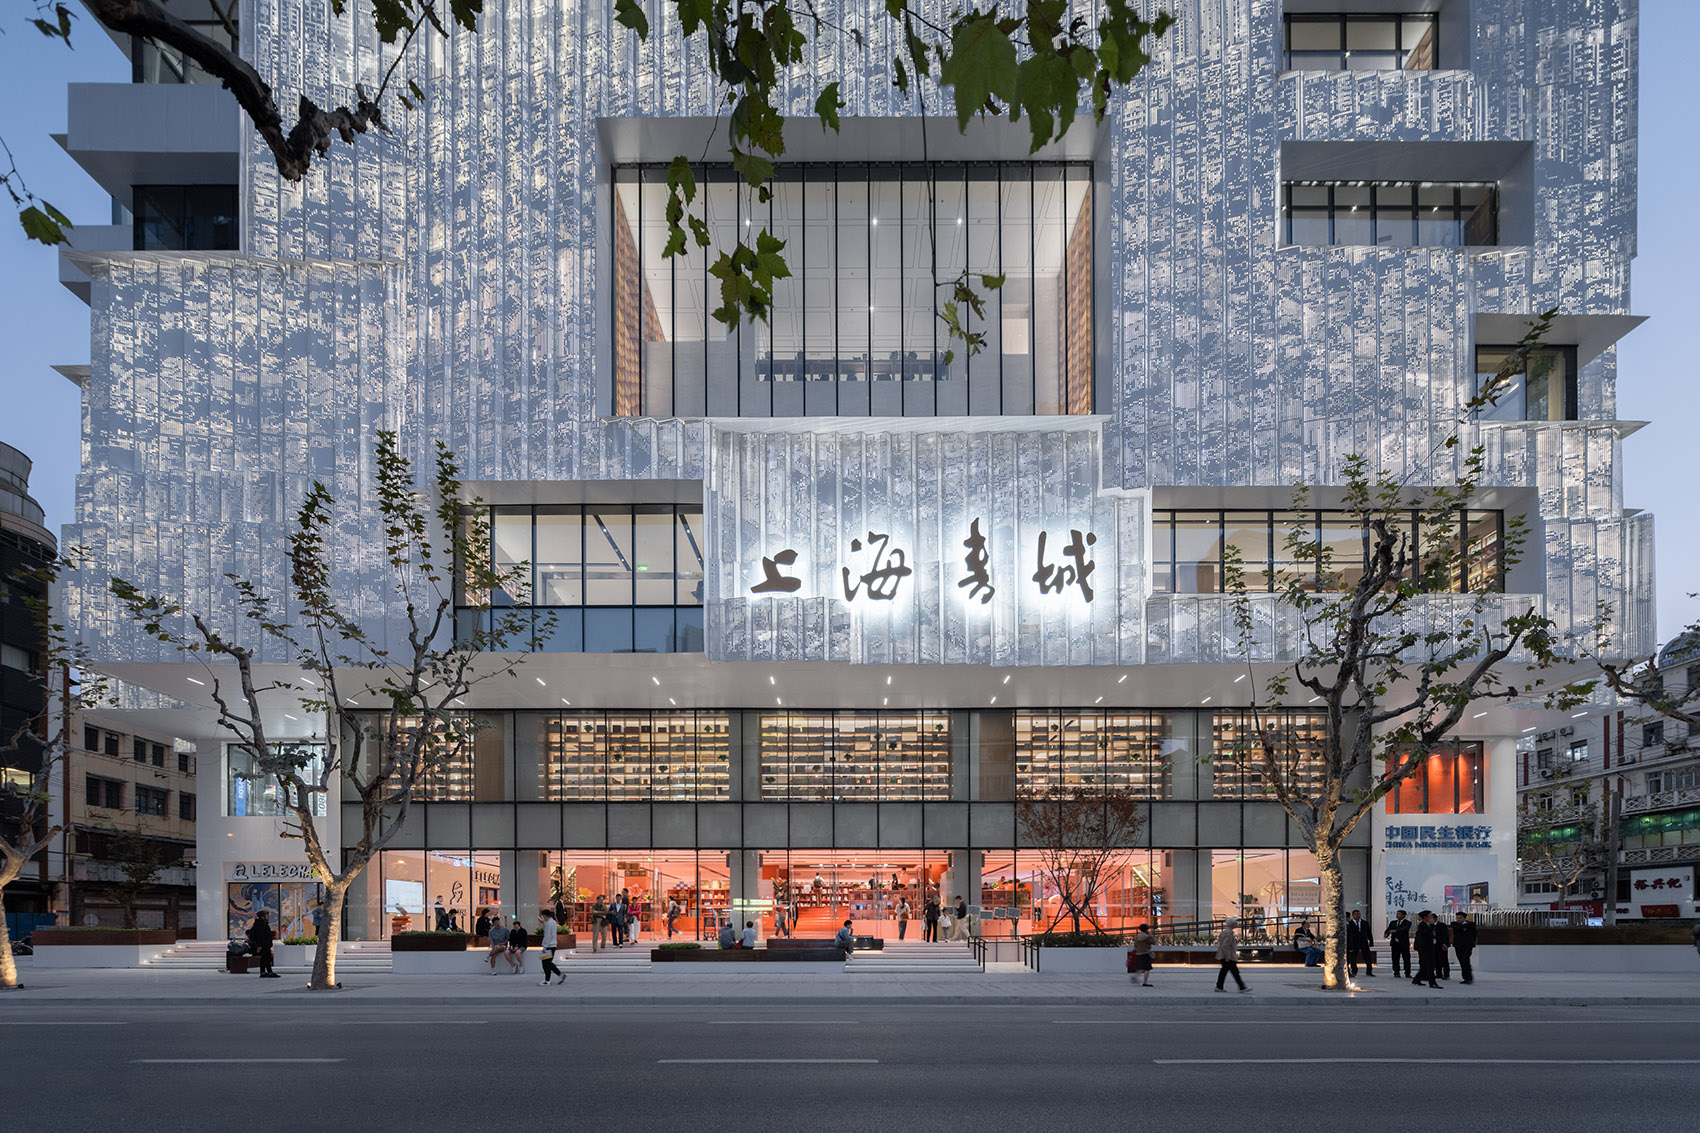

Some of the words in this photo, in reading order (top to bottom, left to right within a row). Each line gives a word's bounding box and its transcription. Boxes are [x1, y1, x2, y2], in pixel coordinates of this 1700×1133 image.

[1385, 825, 1492, 840] 中国民生银行
[250, 864, 315, 879] LELECHA
